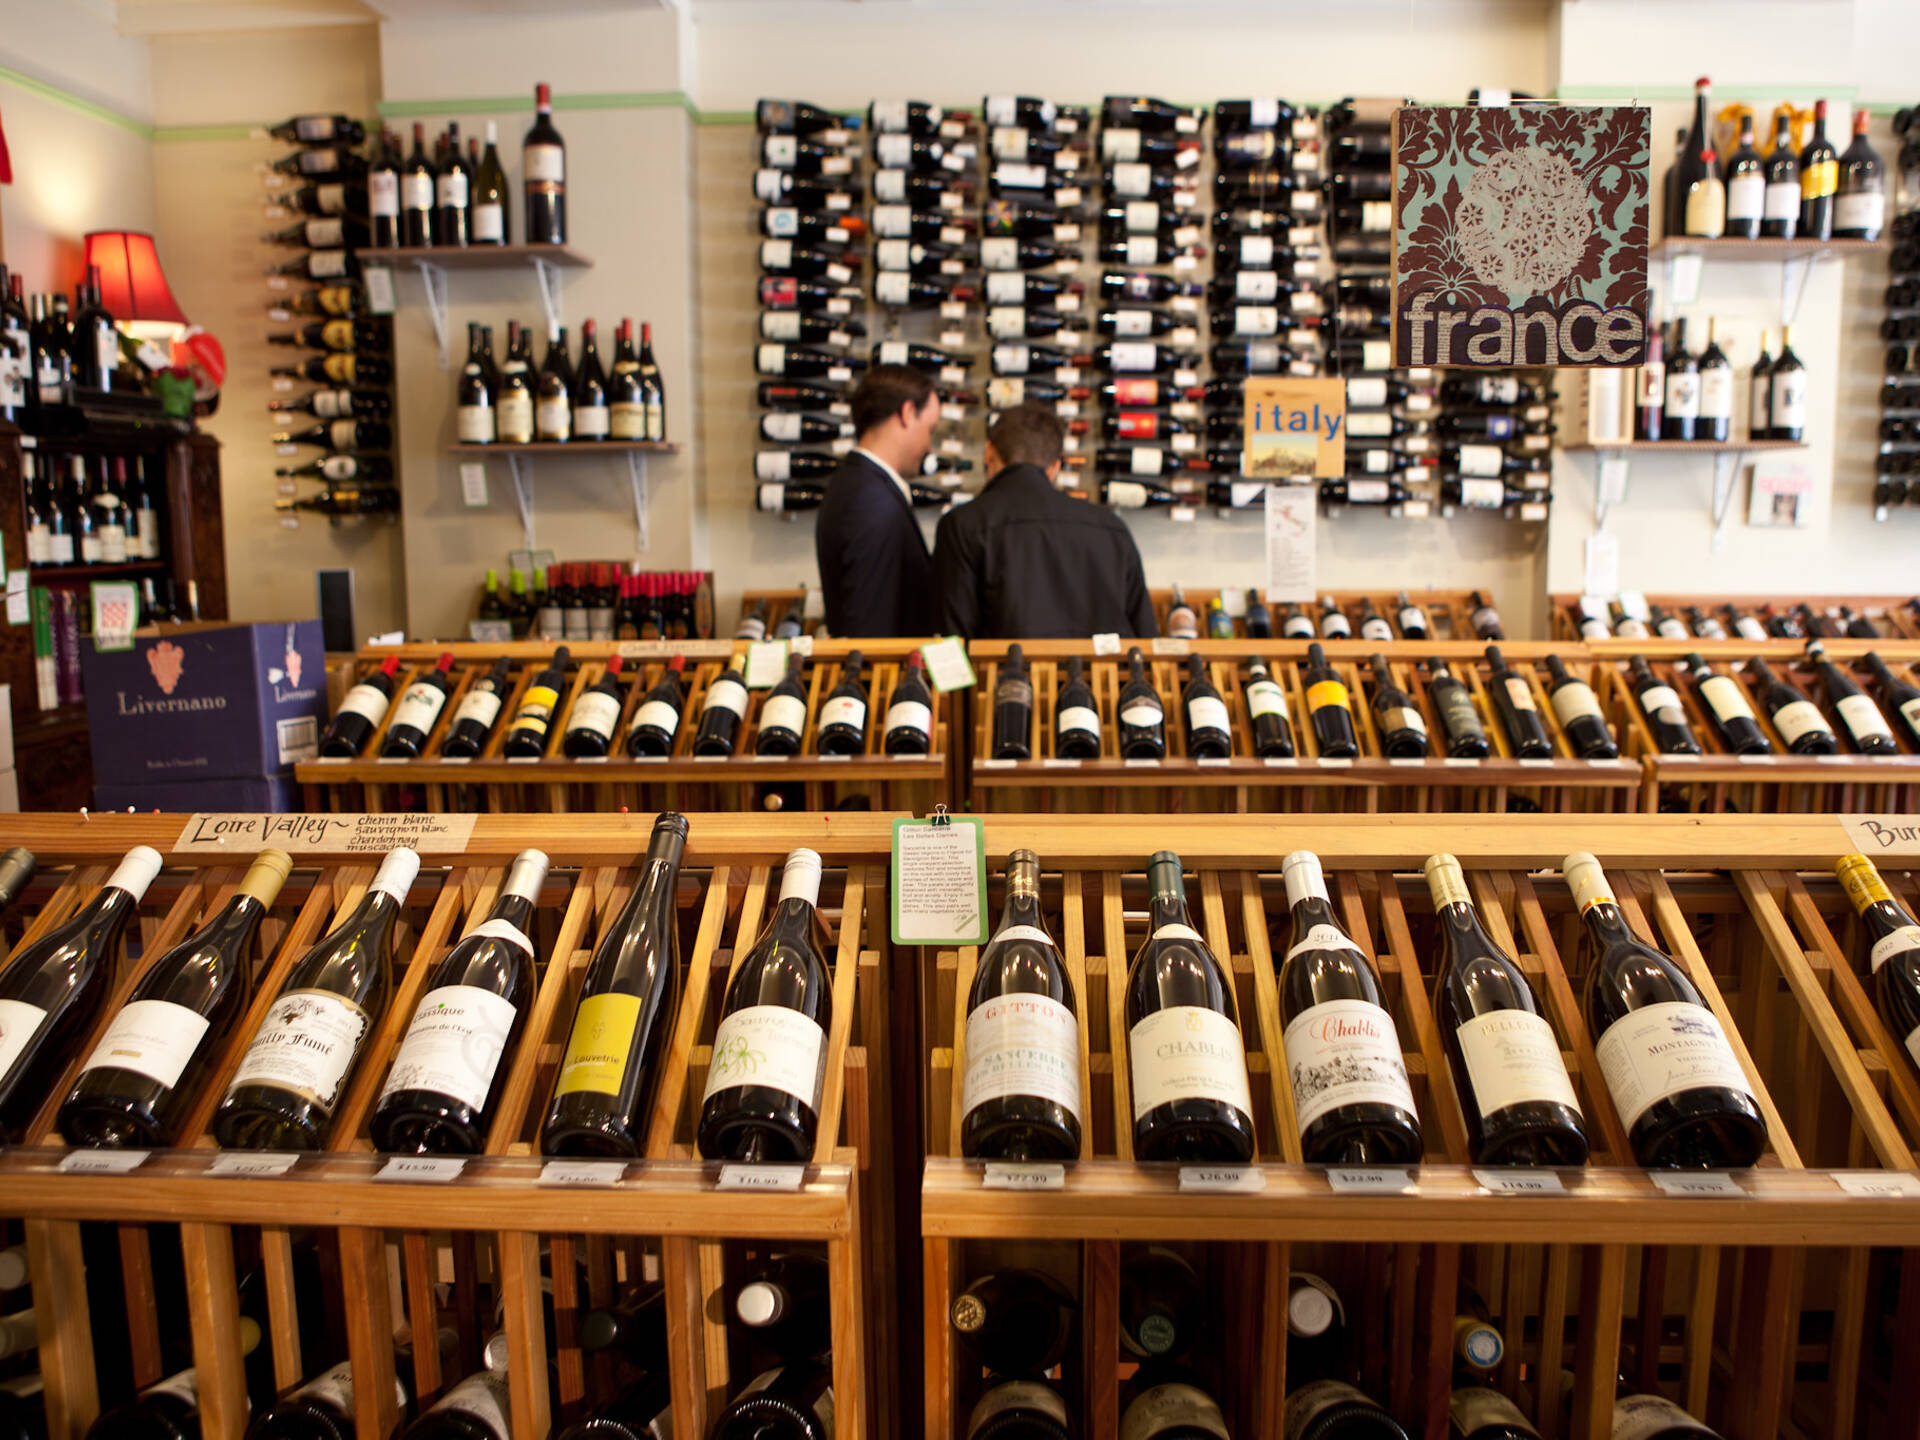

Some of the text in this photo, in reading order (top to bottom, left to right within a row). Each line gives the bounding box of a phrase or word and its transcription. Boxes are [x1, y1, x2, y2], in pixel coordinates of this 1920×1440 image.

[1404, 292, 1642, 365] france
[1254, 403, 1342, 441] italy
[117, 691, 227, 716] Livernano
[190, 815, 435, 844] Loire Valley chenin blanc
[421, 825, 448, 833] blanc
[1860, 820, 1920, 847] Bur
[985, 1002, 1067, 1024] GITTON
[1309, 1016, 1380, 1042] Chablis
[1199, 1172, 1239, 1181] $26.99
